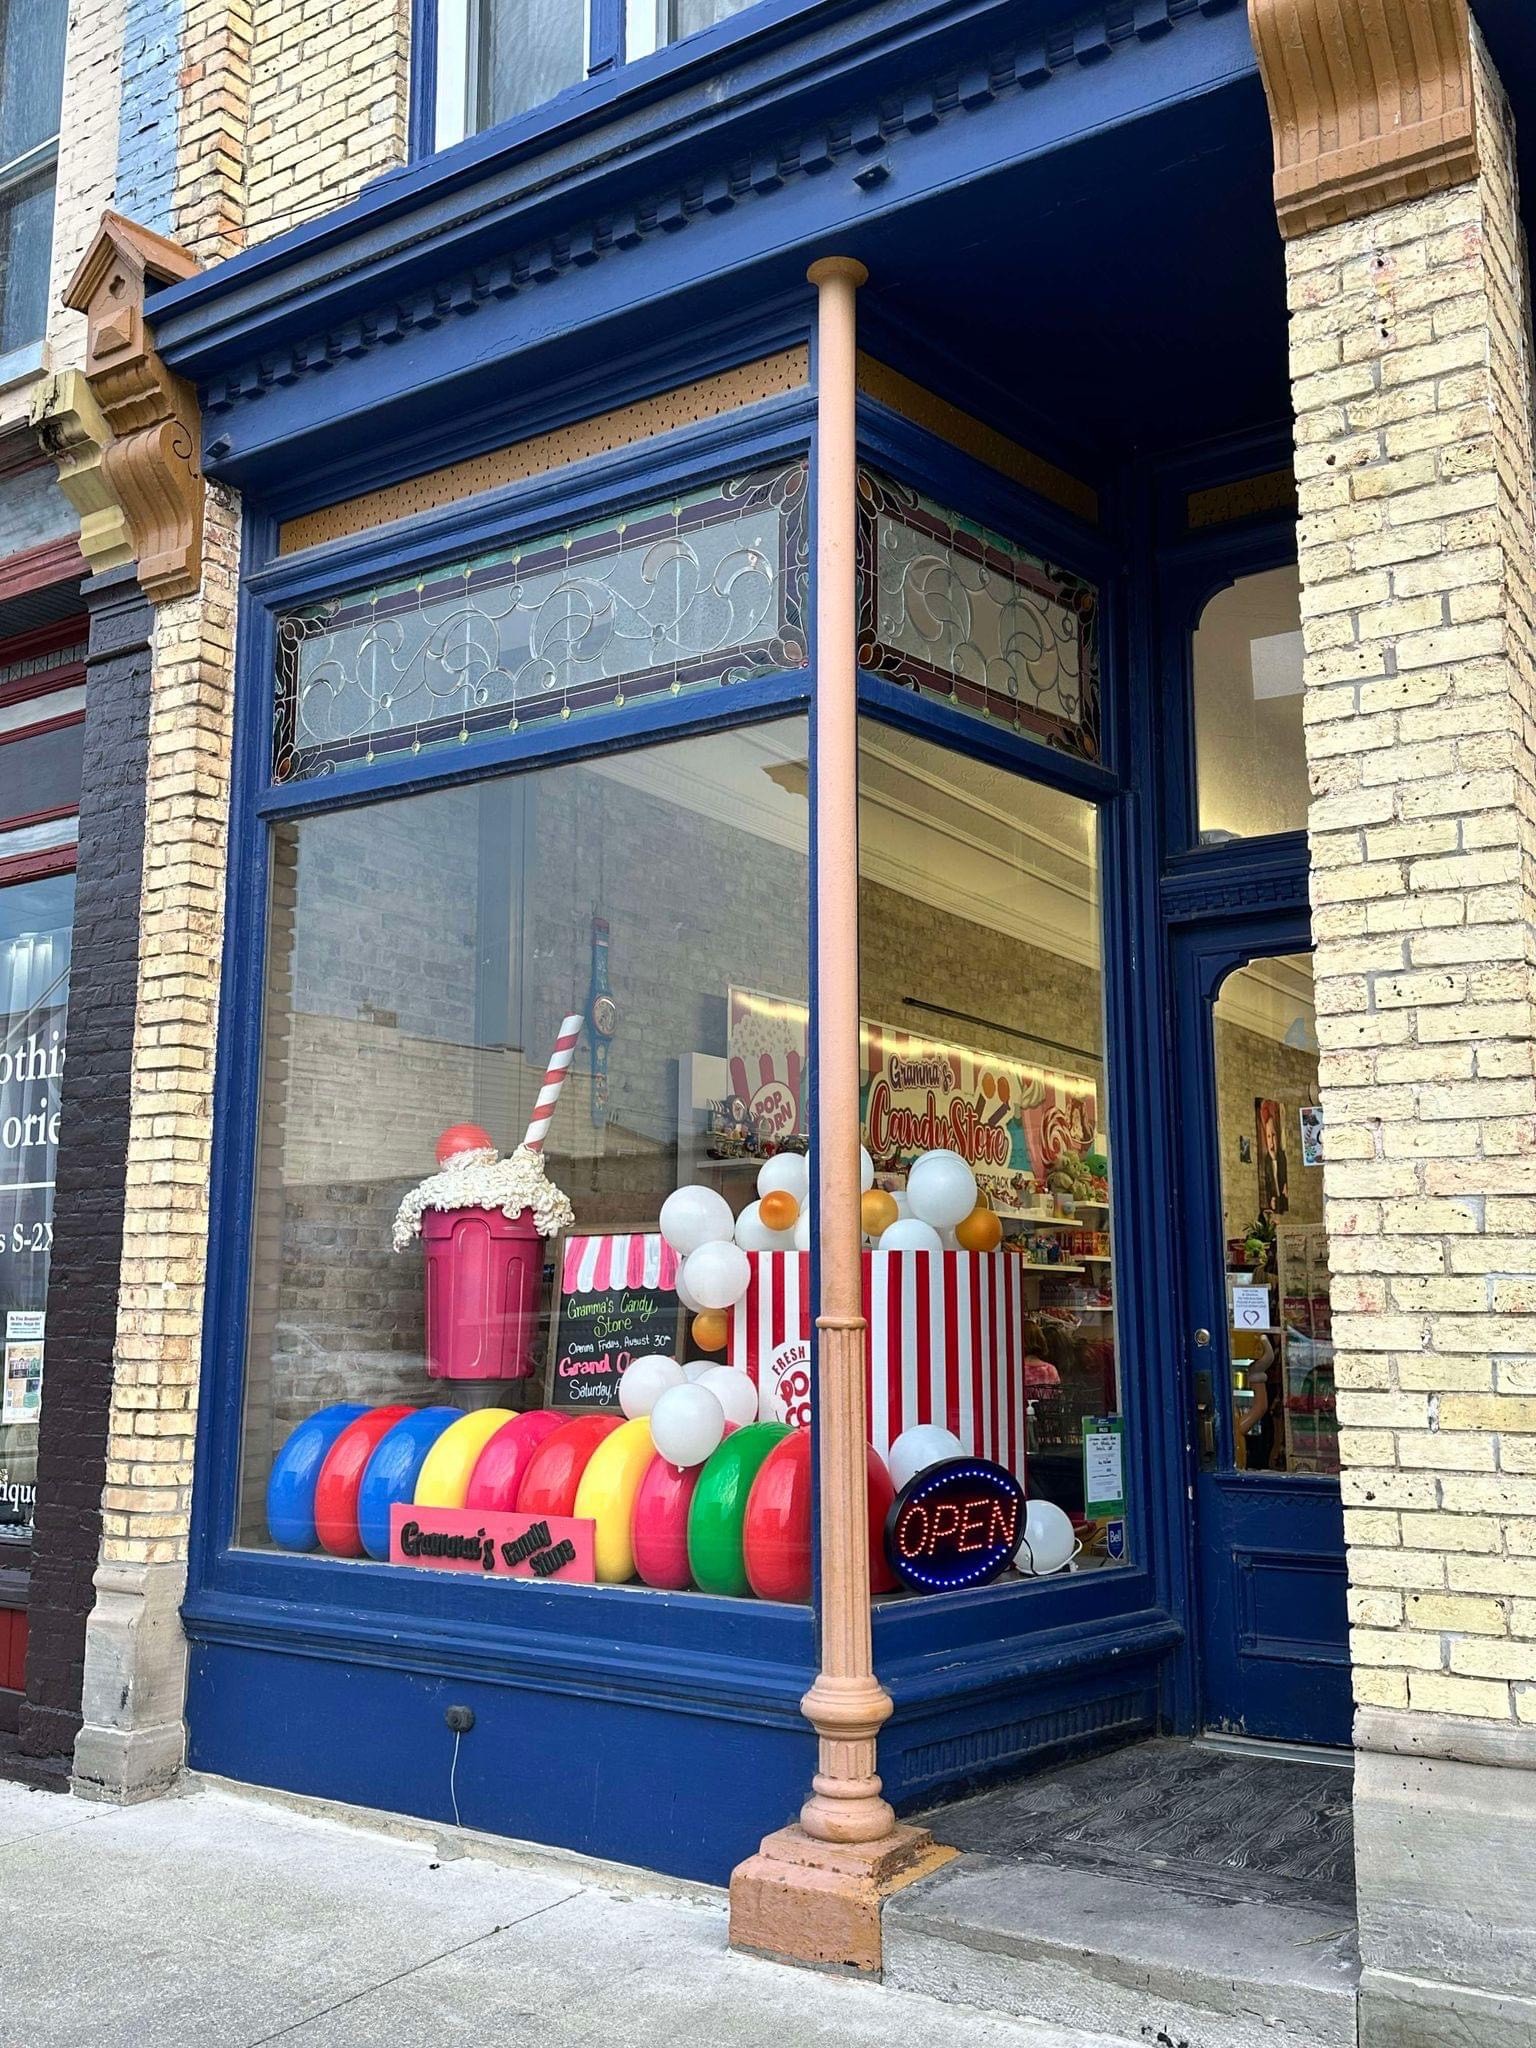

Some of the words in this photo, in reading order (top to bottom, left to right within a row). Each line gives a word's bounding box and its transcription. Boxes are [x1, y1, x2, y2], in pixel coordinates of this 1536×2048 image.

[0, 1030, 66, 1085] othi
[889, 1053, 952, 1094] Gramma's
[870, 1080, 950, 1154] Candy
[949, 1096, 1008, 1166] Store
[567, 1297, 615, 1320] Gramma's
[620, 1292, 658, 1323] Candy
[593, 1315, 632, 1338] Store
[624, 1334, 650, 1347] August
[559, 1353, 613, 1377] Grand
[771, 1345, 806, 1376] FRESH
[569, 1379, 613, 1405] Saturday,
[900, 1499, 1018, 1558] OPEN
[401, 1521, 496, 1570] Gramma's
